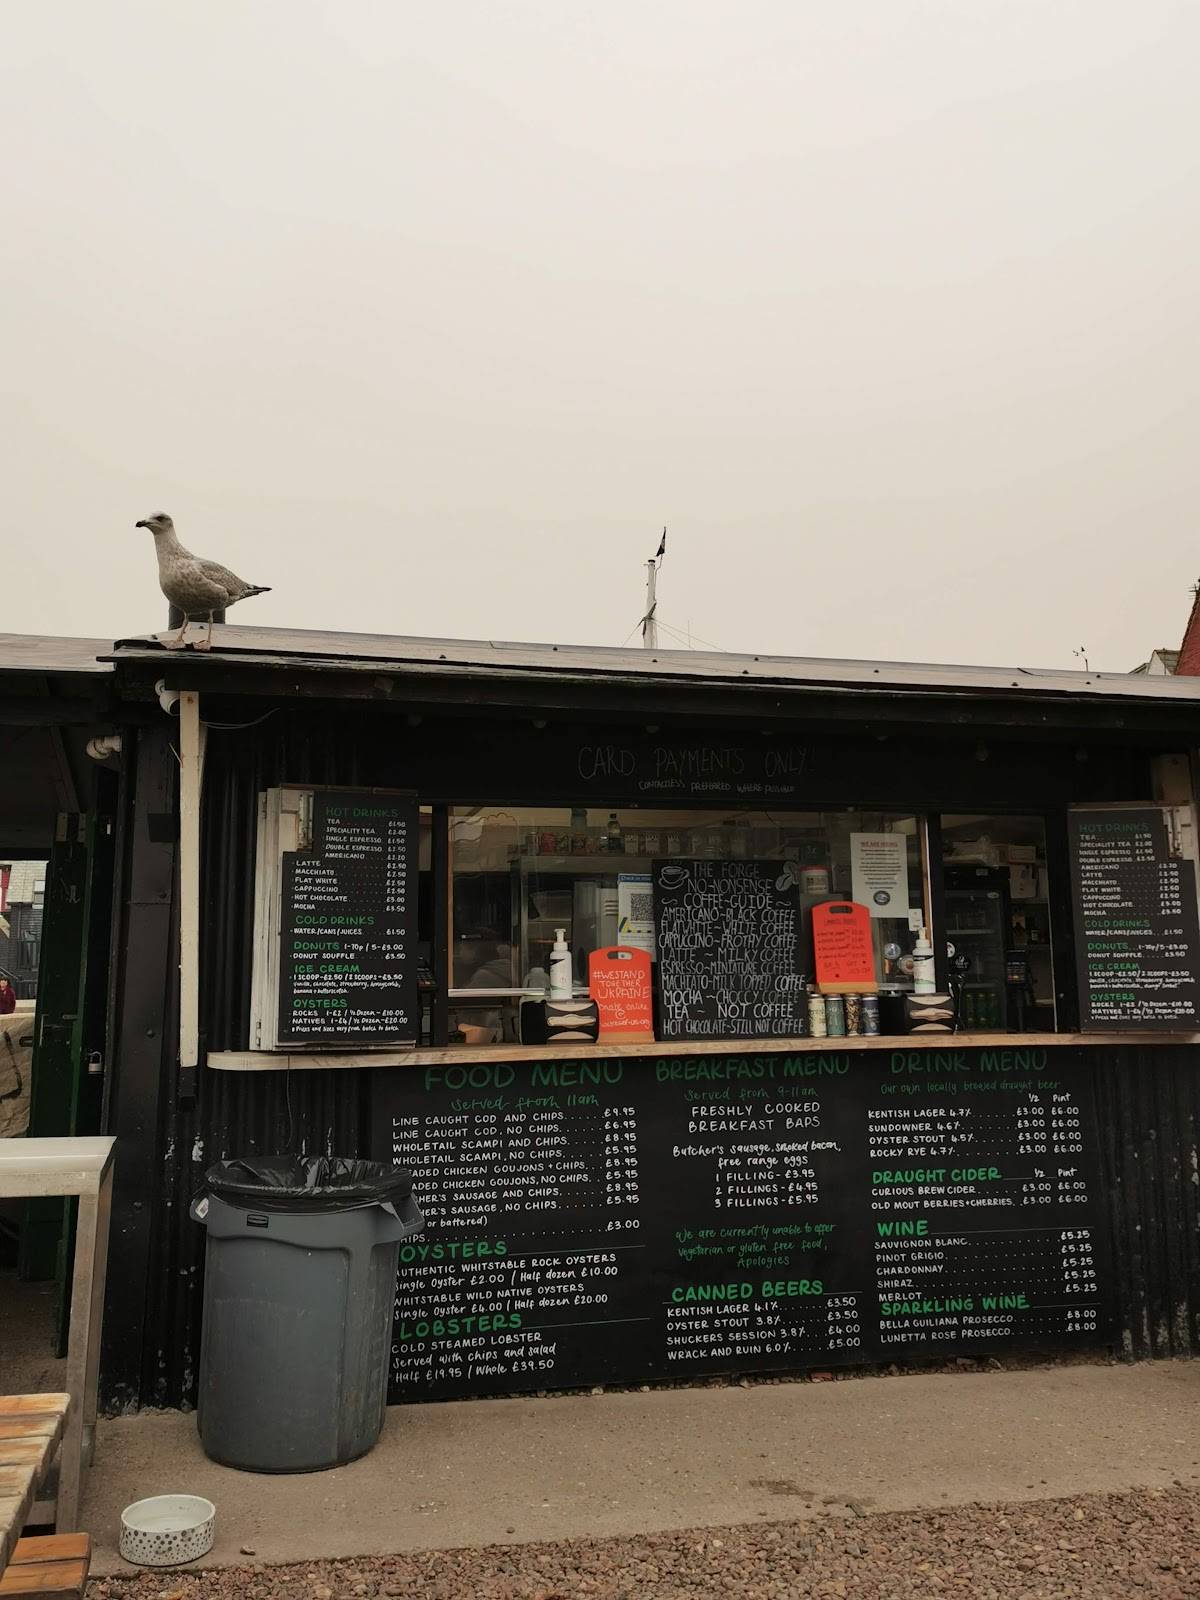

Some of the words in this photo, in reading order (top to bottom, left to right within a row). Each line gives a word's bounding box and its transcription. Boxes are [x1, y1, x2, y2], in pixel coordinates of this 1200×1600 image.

[578, 745, 636, 779] CARD
[653, 748, 745, 778] PAYMENTS
[326, 807, 348, 817] HOT
[353, 808, 398, 817] DRINKS
[326, 826, 360, 835] SPECIALITY
[362, 827, 375, 835] TEA
[1080, 833, 1096, 841] TEA
[325, 852, 365, 860] AMERICANO
[296, 859, 321, 867] LATTE
[387, 862, 406, 870] £2.50
[693, 862, 713, 878] THE
[721, 862, 760, 879] FORGE
[295, 868, 334, 877] MACCHIATO
[387, 870, 406, 878] £2.50
[295, 876, 312, 884] FLAT
[315, 877, 337, 885] WHITE
[386, 879, 405, 887] £2.50
[294, 885, 338, 893] CAPPUCCINO
[387, 887, 405, 895] £2.50
[294, 893, 308, 901] HOT
[310, 894, 347, 903] CHOCOLATE
[294, 902, 315, 911] MOCHA
[386, 905, 405, 913] £3.50
[1083, 901, 1096, 909] HOT
[1098, 901, 1133, 909] CHOCOLATE
[1084, 909, 1107, 917] MOCHA
[295, 915, 327, 925] COLD
[330, 916, 374, 925] DRINKS
[1085, 919, 1110, 928] COLD
[1113, 919, 1150, 928] DRINKS
[386, 928, 405, 936] £1.50
[294, 941, 339, 950] DONUTS
[1087, 942, 1128, 950] DONUTS
[293, 952, 318, 960] DONUT
[322, 952, 355, 960] SOUFFLE
[385, 952, 405, 961] £3.50
[661, 947, 697, 962] LATTE
[717, 947, 758, 962] MILKY
[760, 948, 795, 962] COFFEE
[295, 965, 314, 973] ICE
[320, 965, 360, 973] CREAM
[1088, 962, 1104, 971] ICE
[1107, 962, 1140, 971] CREAM
[597, 986, 650, 999] UKRAINE
[664, 989, 703, 1006] MOCHA
[1090, 993, 1135, 1001] OYSTERS
[293, 999, 347, 1008] OYSTERS
[293, 1009, 318, 1017] ROCKS
[667, 1003, 689, 1019] TEA
[717, 1003, 748, 1018] NOT
[753, 1003, 793, 1018] COFFEE
[292, 1017, 325, 1025] NATIVES
[656, 1058, 778, 1081] BREAKFAST
[784, 1056, 849, 1077] MENU
[891, 1052, 971, 1074] DRINK
[980, 1050, 1047, 1072] MENU
[425, 1065, 515, 1091] FOOD
[532, 1059, 623, 1086] MENU
[692, 1105, 753, 1117] FRESHLY
[765, 1102, 820, 1114] COOKED
[868, 1109, 910, 1119] KENTISH
[914, 1108, 947, 1118] LAGER
[950, 1108, 972, 1117] 4.7%
[1016, 1107, 1044, 1116] £3.00
[1051, 1107, 1079, 1115] £6.00
[393, 1117, 419, 1126] LINE
[425, 1115, 469, 1125] CAUGHT
[474, 1115, 497, 1123] COD
[504, 1113, 527, 1122] AND
[532, 1112, 564, 1121] CHIPS
[604, 1107, 635, 1117] £9.95
[688, 1119, 774, 1133] BREAKFAST
[786, 1116, 820, 1129] BAPS
[393, 1141, 456, 1152] WHOLETAIL
[461, 1139, 503, 1149] SCAMPI
[508, 1138, 531, 1147] AND
[535, 1136, 567, 1146] CHIPS
[605, 1133, 637, 1142] £8.95
[718, 1157, 741, 1169] free
[747, 1157, 778, 1169] range
[784, 1156, 808, 1168] eggs
[873, 1169, 946, 1184] DRAUGHT
[951, 1167, 1002, 1181] CIDER
[872, 1187, 914, 1196] CURIOUS
[918, 1186, 945, 1195] BREW
[947, 1185, 976, 1194] CIDER
[1022, 1183, 1052, 1192] £3.00
[1058, 1182, 1086, 1190] £6.00
[427, 1219, 437, 1227] or
[440, 1216, 488, 1227] battered)
[877, 1220, 928, 1237] WINE
[874, 1239, 932, 1250] SAUVIGNON
[935, 1238, 968, 1247] BLANC
[1061, 1230, 1090, 1241] £5.25
[400, 1241, 507, 1262] OYSTERS
[671, 1283, 753, 1302] CANNED
[762, 1280, 823, 1297] BEERS
[433, 1304, 466, 1317] Oyster
[471, 1302, 502, 1313] £4.00
[514, 1299, 535, 1310] Half
[539, 1297, 570, 1307] dozen
[574, 1294, 608, 1305] £20.00
[667, 1306, 713, 1317] KENTISH
[716, 1304, 750, 1314] LAGER
[754, 1301, 778, 1312] 4.1%
[827, 1297, 856, 1308] £3.50
[880, 1296, 974, 1316] SPARKLING
[982, 1295, 1030, 1310] WINE
[666, 1320, 709, 1331] OYSTER
[714, 1317, 749, 1328] STOUT
[756, 1315, 781, 1326] 3.8%
[827, 1311, 858, 1321] £3.50
[879, 1319, 910, 1330] BELLA
[913, 1317, 959, 1327] GUILIANA
[963, 1315, 1013, 1325] PROSECCO
[1067, 1309, 1096, 1319] £8.00
[400, 1313, 521, 1340] LOBSTERS
[392, 1342, 425, 1354] COLD
[431, 1337, 486, 1350] STEAMED
[491, 1332, 542, 1345] LOBSTER
[667, 1350, 708, 1360] WRACK
[711, 1347, 732, 1357] AND
[736, 1345, 761, 1355] RUIN
[765, 1342, 791, 1353] 6.0%
[828, 1337, 860, 1349] £5.00
[393, 1354, 432, 1369] Served
[439, 1352, 463, 1364] with
[467, 1350, 498, 1362] chips
[504, 1345, 524, 1358] and
[528, 1343, 556, 1357] salad
[396, 1370, 420, 1383] Half
[426, 1367, 462, 1381] £19.95
[476, 1363, 508, 1375] Whole
[512, 1359, 554, 1372] £39.50
